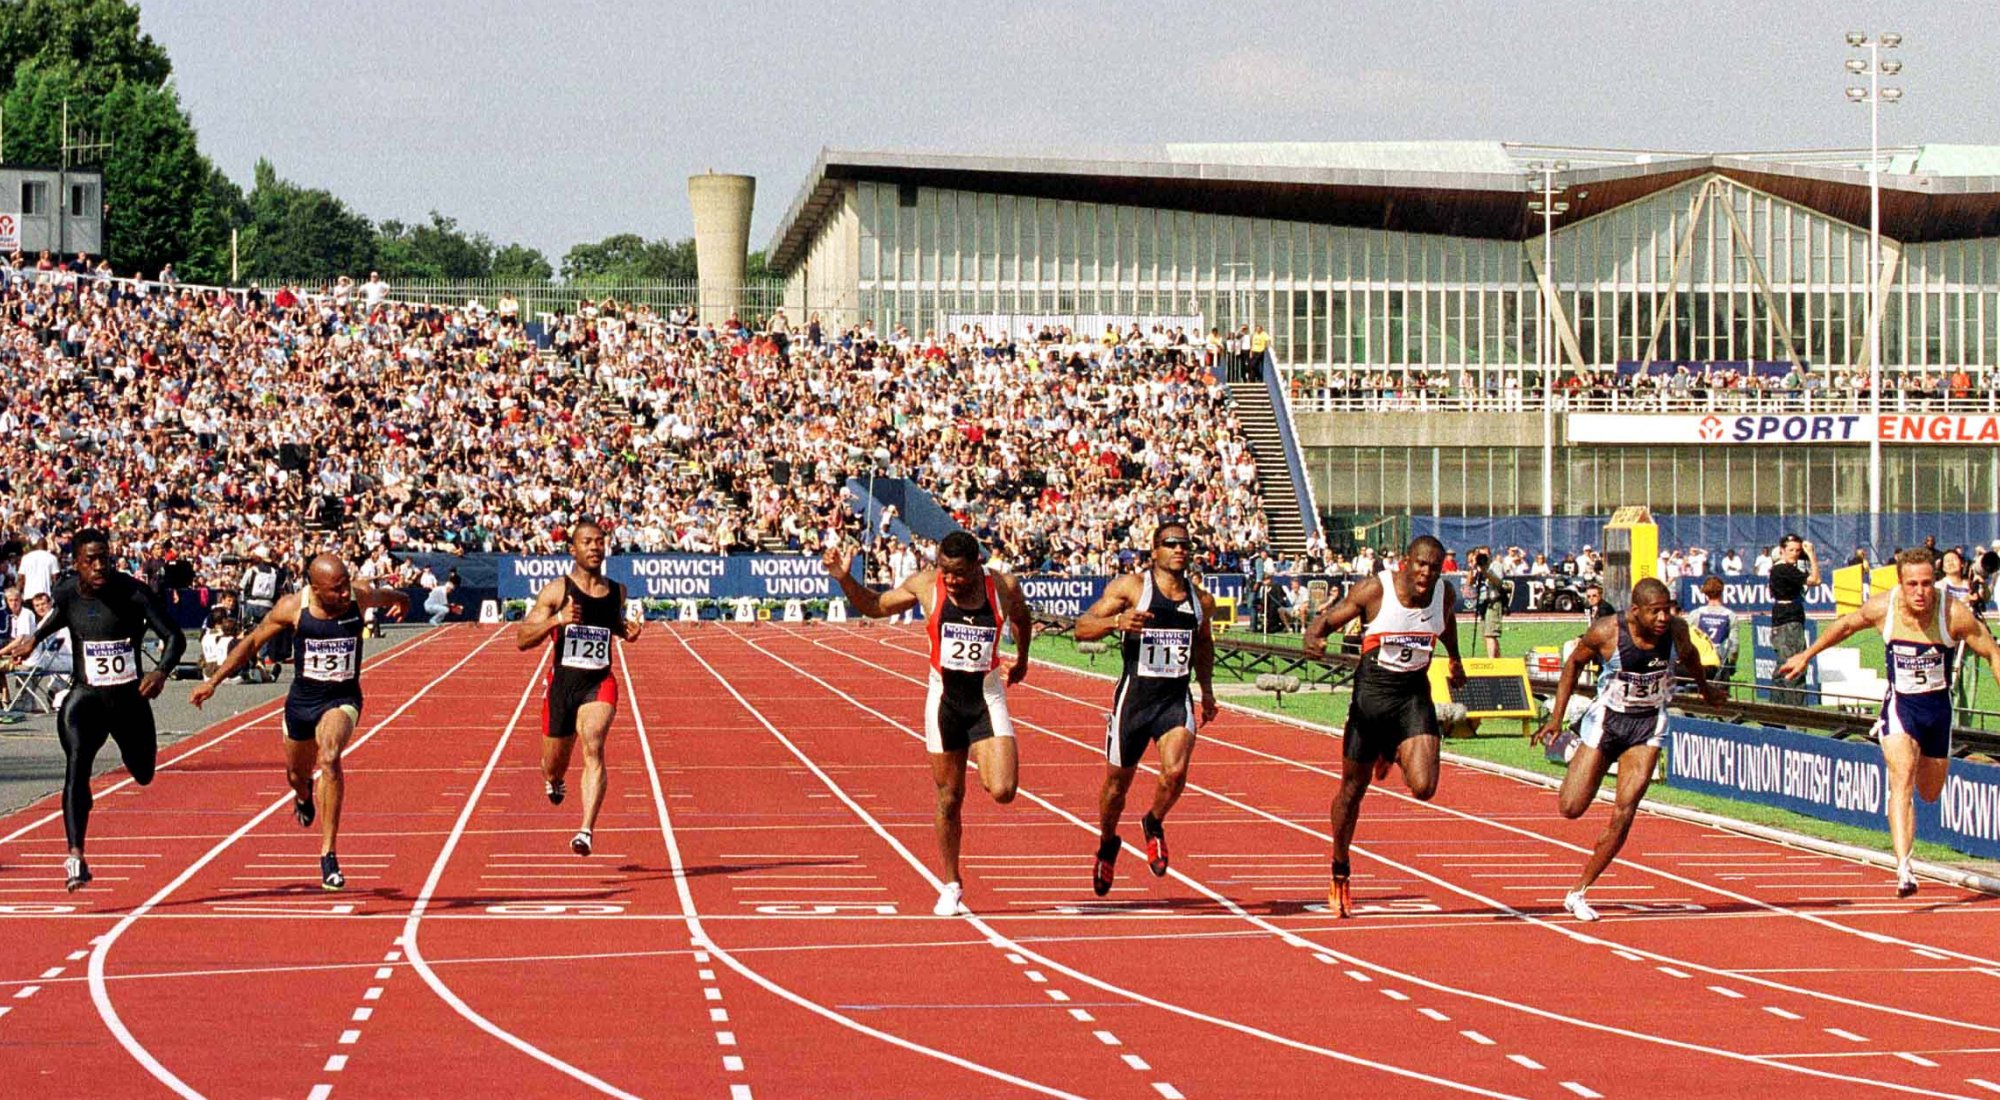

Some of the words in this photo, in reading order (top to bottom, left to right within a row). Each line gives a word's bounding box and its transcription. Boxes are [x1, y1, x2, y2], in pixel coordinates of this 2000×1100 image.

[1732, 416, 1860, 441] SPORT
[1878, 416, 1999, 441] ENGLA
[632, 559, 725, 576] NORWICH
[751, 559, 830, 576] NORWIC
[646, 578, 710, 595] UNION
[765, 578, 829, 595] UNION
[1020, 581, 1093, 598] ORWICH
[486, 603, 493, 618] 8
[684, 604, 691, 618] 4
[741, 604, 748, 617] 3
[789, 604, 797, 617] 2
[833, 604, 839, 617] 1
[1025, 599, 1080, 616] NION
[945, 625, 994, 636] NORWICH
[953, 633, 986, 642] UNION
[1145, 631, 1190, 639] NORWICH
[1708, 627, 1718, 639] 7
[570, 640, 607, 659] 128
[1153, 638, 1183, 646] UNION
[952, 641, 983, 661] 28
[1147, 646, 1189, 665] 113
[1399, 648, 1413, 663] 9
[95, 655, 126, 675] 30
[311, 653, 351, 671] 131
[1914, 670, 1928, 685] 5
[1672, 731, 1736, 787] NORWICH
[1737, 743, 1781, 794] UNION
[1784, 749, 1831, 805] BRITISH
[1834, 758, 1881, 814] GRAND
[1941, 774, 2000, 841] NORWI
